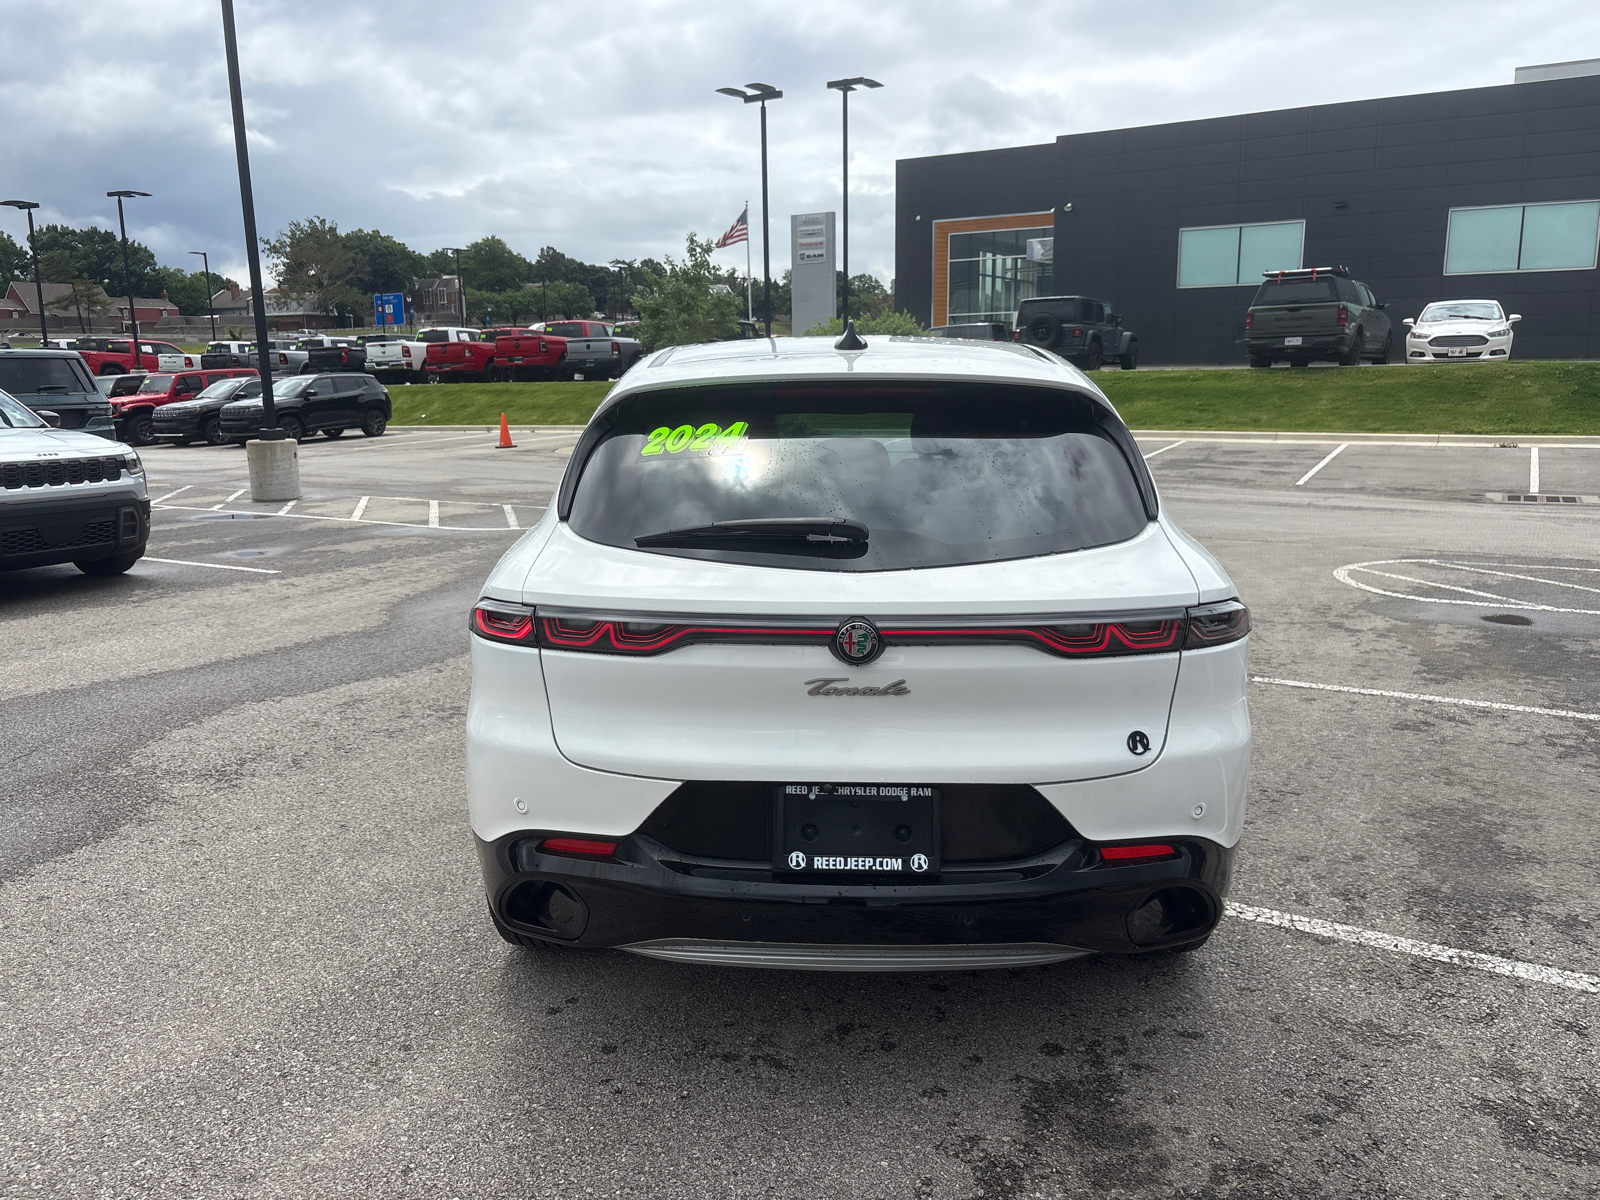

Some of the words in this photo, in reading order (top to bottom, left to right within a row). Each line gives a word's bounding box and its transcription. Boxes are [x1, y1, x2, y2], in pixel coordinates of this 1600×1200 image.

[640, 421, 749, 457] 2024
[838, 625, 853, 644] ALFA
[855, 624, 877, 644] ROMEO
[804, 677, 912, 697] Tonale
[785, 785, 808, 795] REED
[879, 786, 909, 797] DODGE
[910, 787, 932, 797] RAM
[813, 856, 903, 871] REEDJEEP.COM
